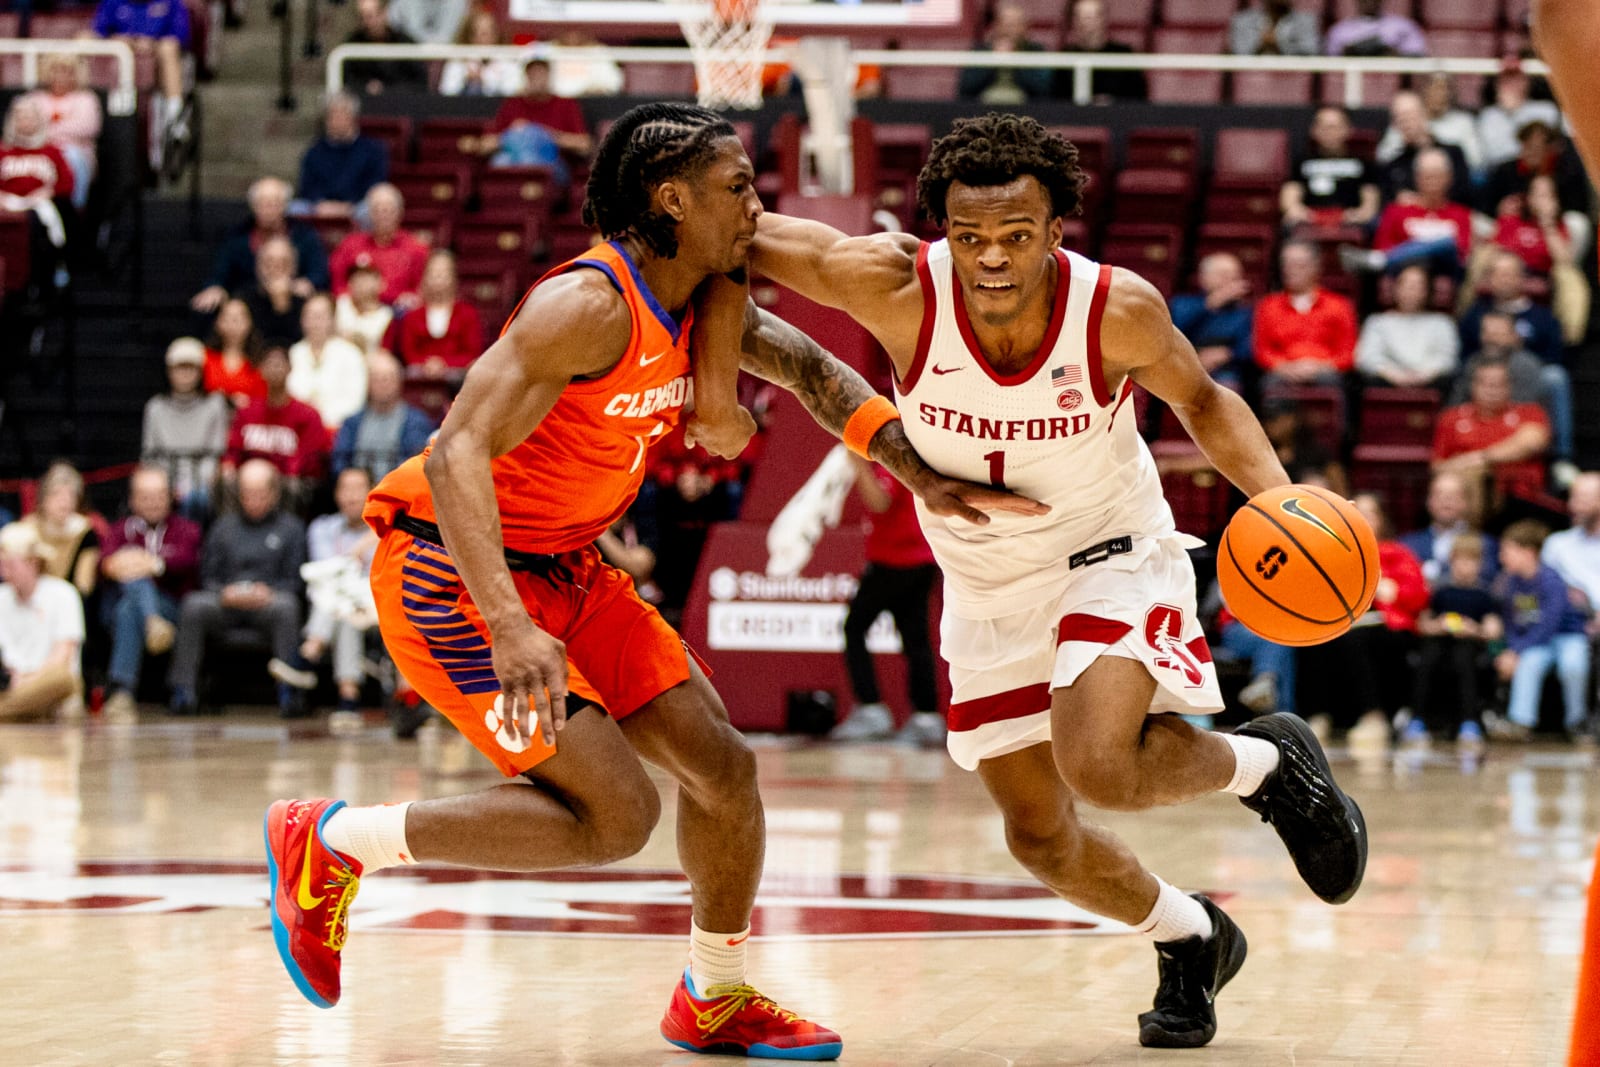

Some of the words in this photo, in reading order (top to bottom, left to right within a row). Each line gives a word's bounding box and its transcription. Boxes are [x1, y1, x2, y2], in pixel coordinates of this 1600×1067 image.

[919, 402, 1091, 441] STANFORD
[983, 450, 1006, 488] 1
[738, 571, 835, 601] Stanford
